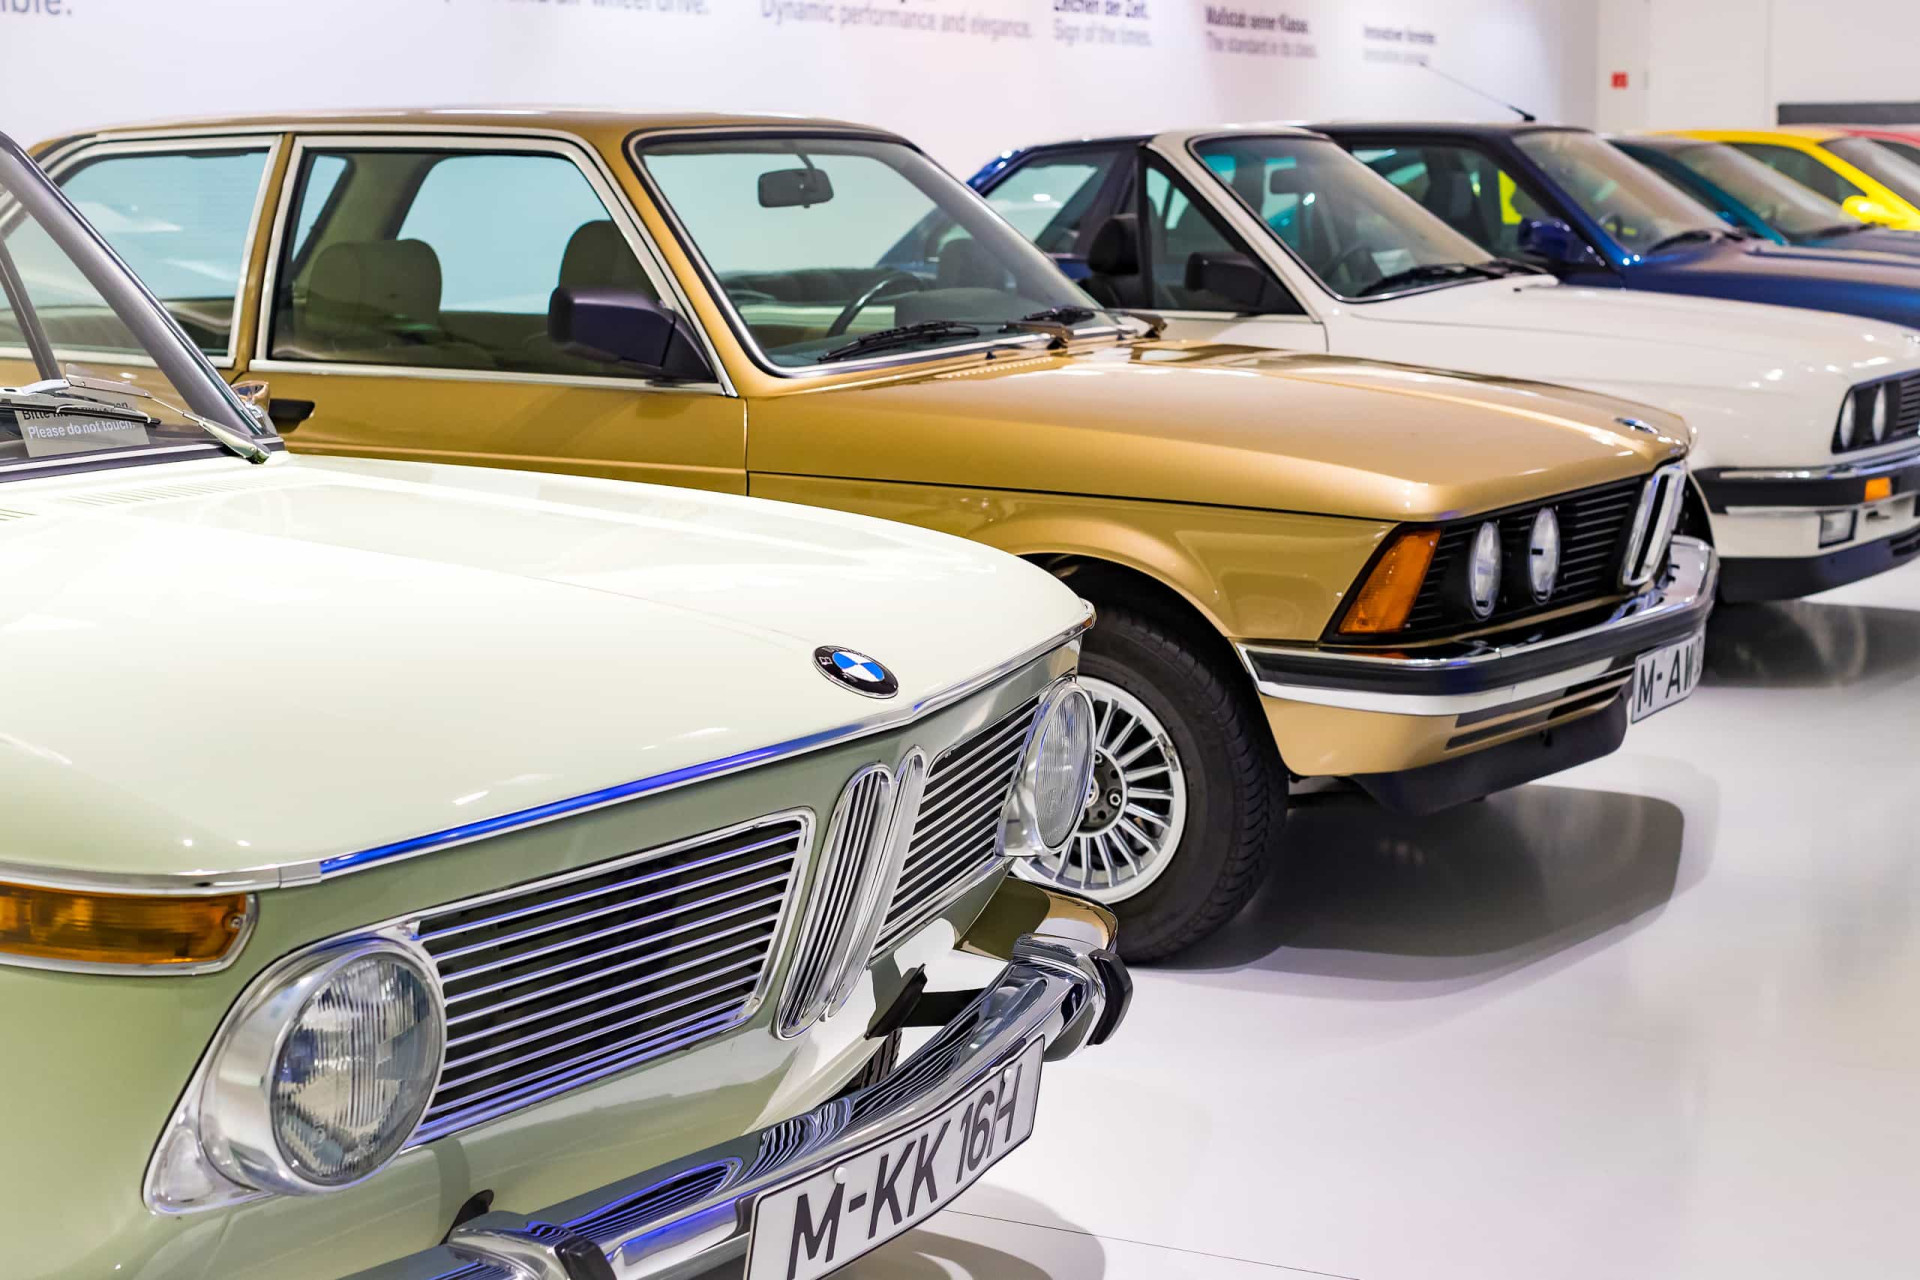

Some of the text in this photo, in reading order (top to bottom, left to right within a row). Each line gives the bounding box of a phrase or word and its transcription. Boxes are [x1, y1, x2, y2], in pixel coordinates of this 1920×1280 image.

[761, 0, 835, 26] Dynamic
[840, 3, 936, 31] performance
[941, 9, 966, 33] and
[1053, 18, 1080, 47] Sign
[28, 420, 135, 440] Please do not touch.
[788, 1063, 1022, 1280] M-KK 16H
